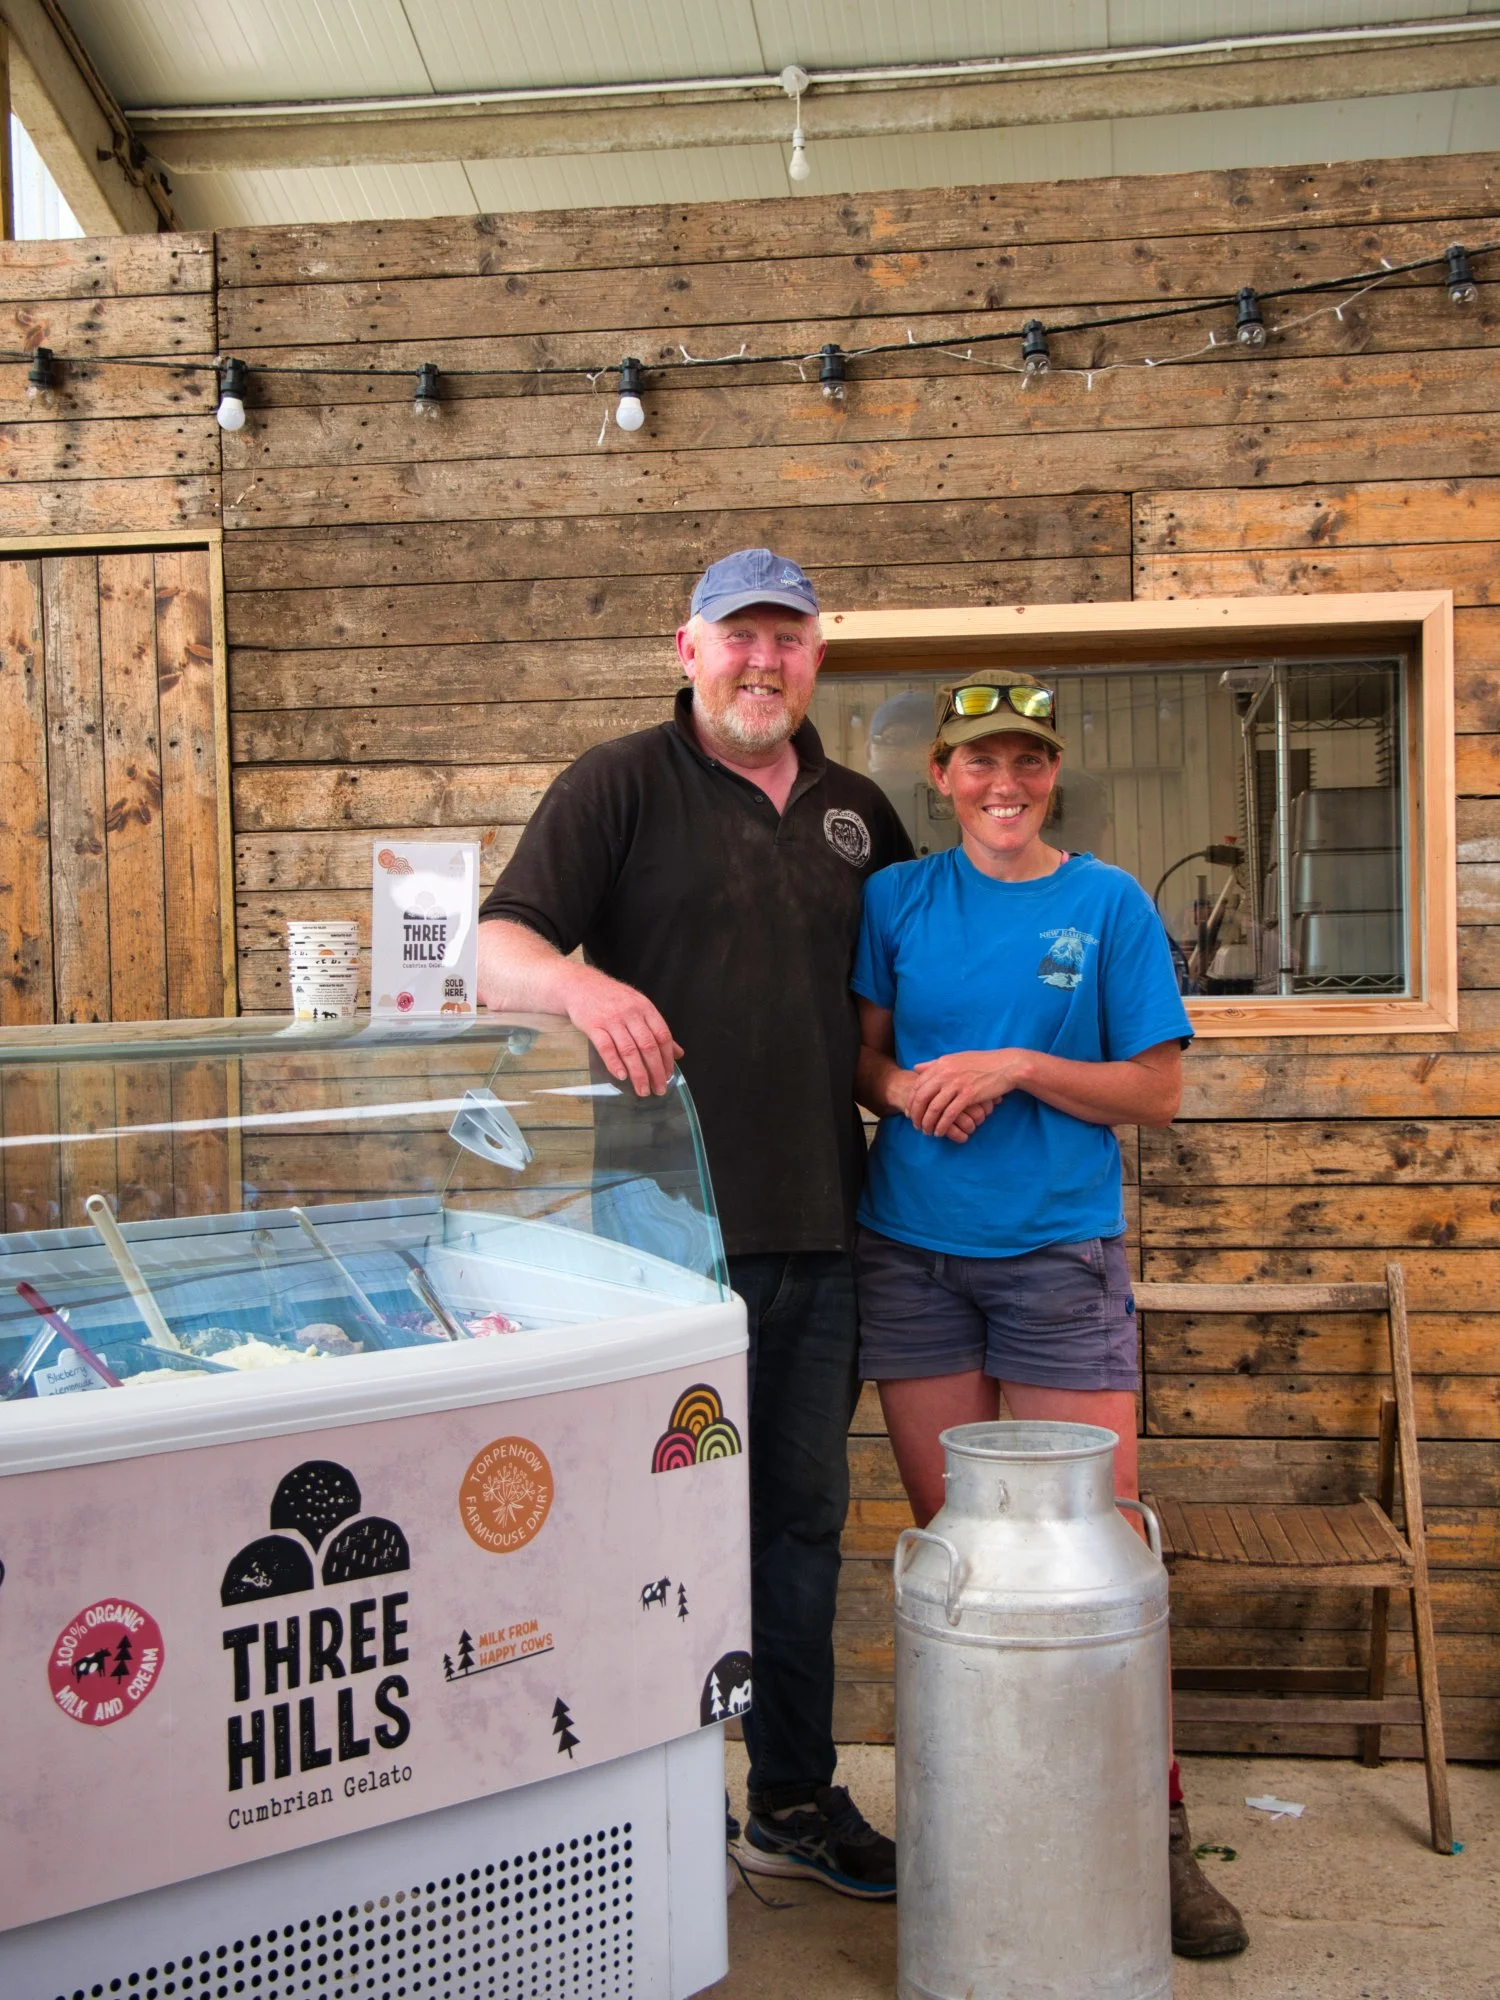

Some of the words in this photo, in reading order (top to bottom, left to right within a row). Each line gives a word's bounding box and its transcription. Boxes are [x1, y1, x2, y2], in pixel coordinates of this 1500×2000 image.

[403, 924, 447, 941] THREE
[1040, 929, 1060, 938] NEW
[403, 943, 446, 961] HILLS
[445, 979, 464, 988] SOLD
[445, 988, 464, 997] HERE
[47, 1367, 88, 1384] Blueberry
[470, 1444, 543, 1483] TORPENHOW
[466, 1495, 526, 1546] FARMHOUSE
[526, 1485, 548, 1530] DAIRY
[56, 1622, 88, 1667] 100%
[85, 1604, 144, 1632] ORGANIC
[223, 1591, 409, 1702] THREE
[479, 1628, 505, 1648] MILK
[508, 1619, 538, 1639] FROM
[479, 1643, 517, 1666] HAPPY
[520, 1633, 553, 1654] COWS
[55, 1685, 88, 1719] MILK
[94, 1697, 123, 1721] AND
[127, 1647, 159, 1700] CREAM
[227, 1674, 411, 1792] HILLS
[228, 1787, 333, 1830] Cumbrian
[344, 1765, 412, 1798] Gelato
